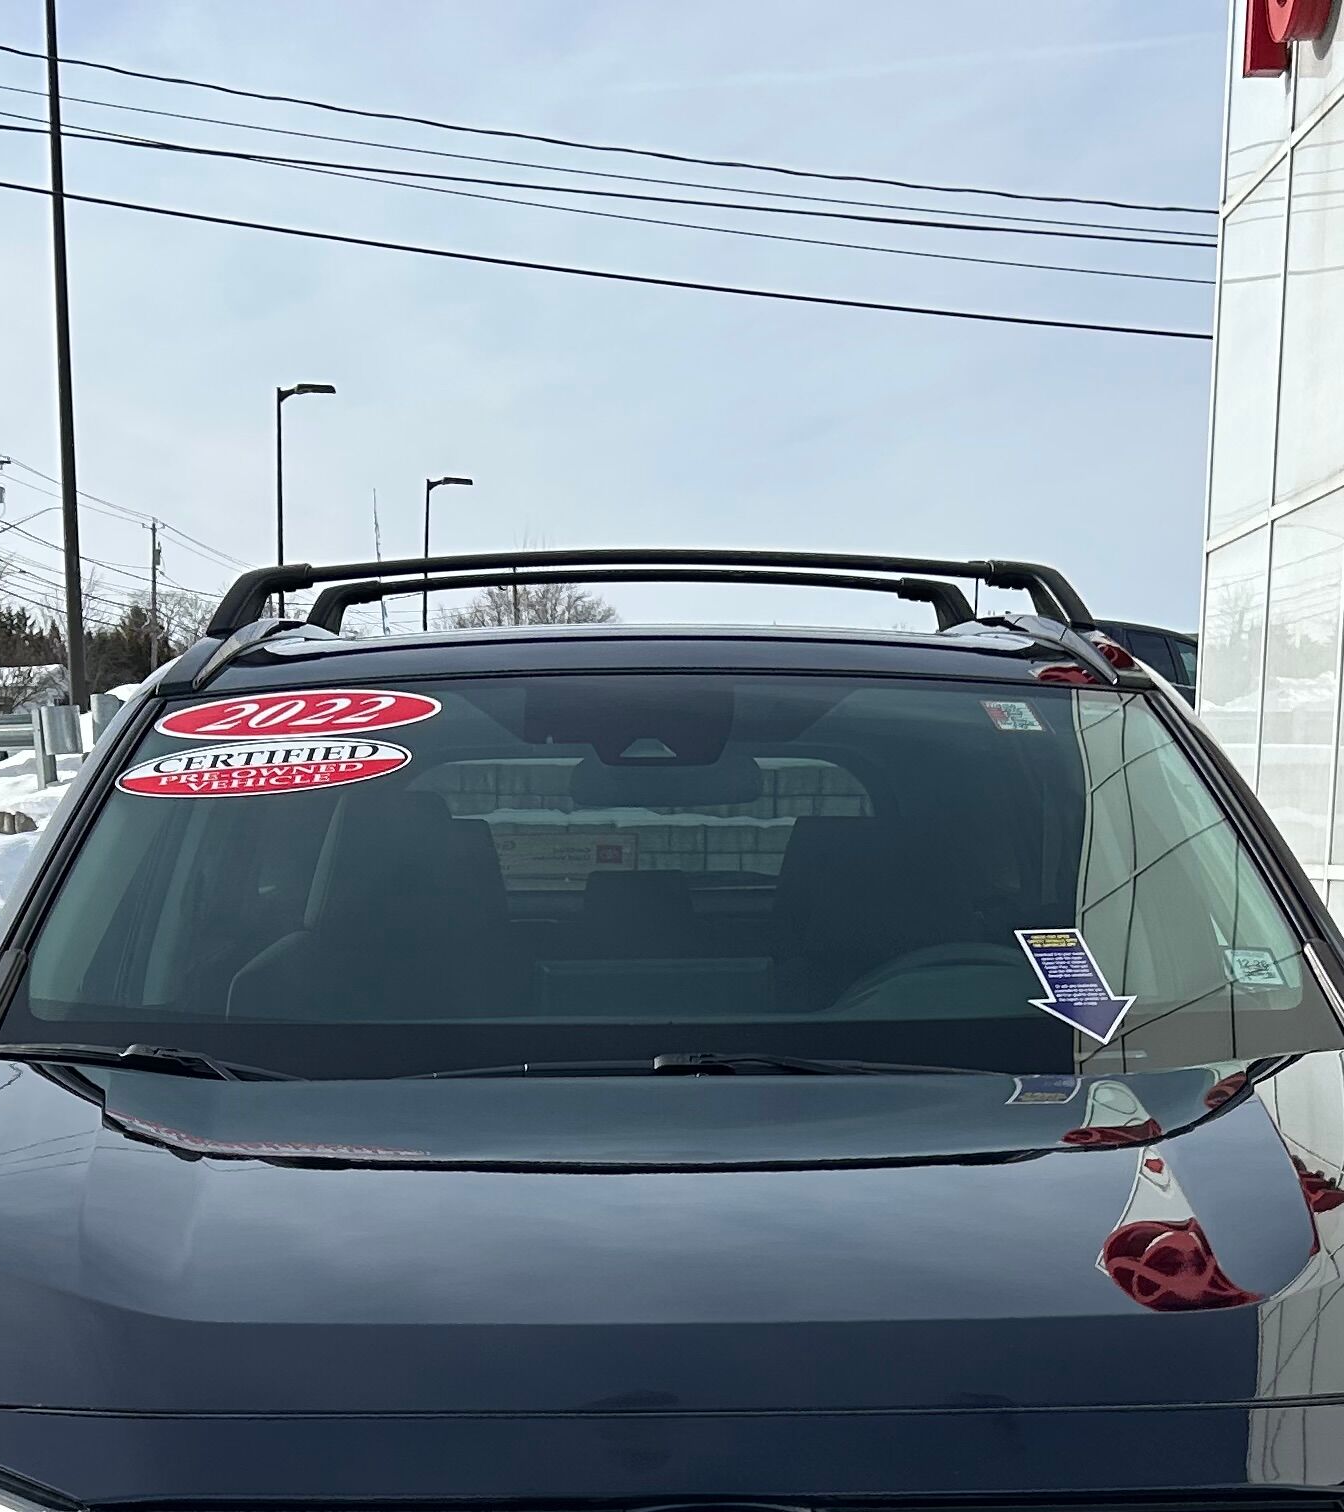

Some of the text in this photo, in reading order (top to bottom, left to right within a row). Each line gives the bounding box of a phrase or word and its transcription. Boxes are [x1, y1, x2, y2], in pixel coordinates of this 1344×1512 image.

[197, 696, 397, 733] 2022
[153, 743, 380, 774] CERTIFIED
[158, 762, 364, 787] PRE-OWNED
[187, 773, 332, 792] VEHICLE
